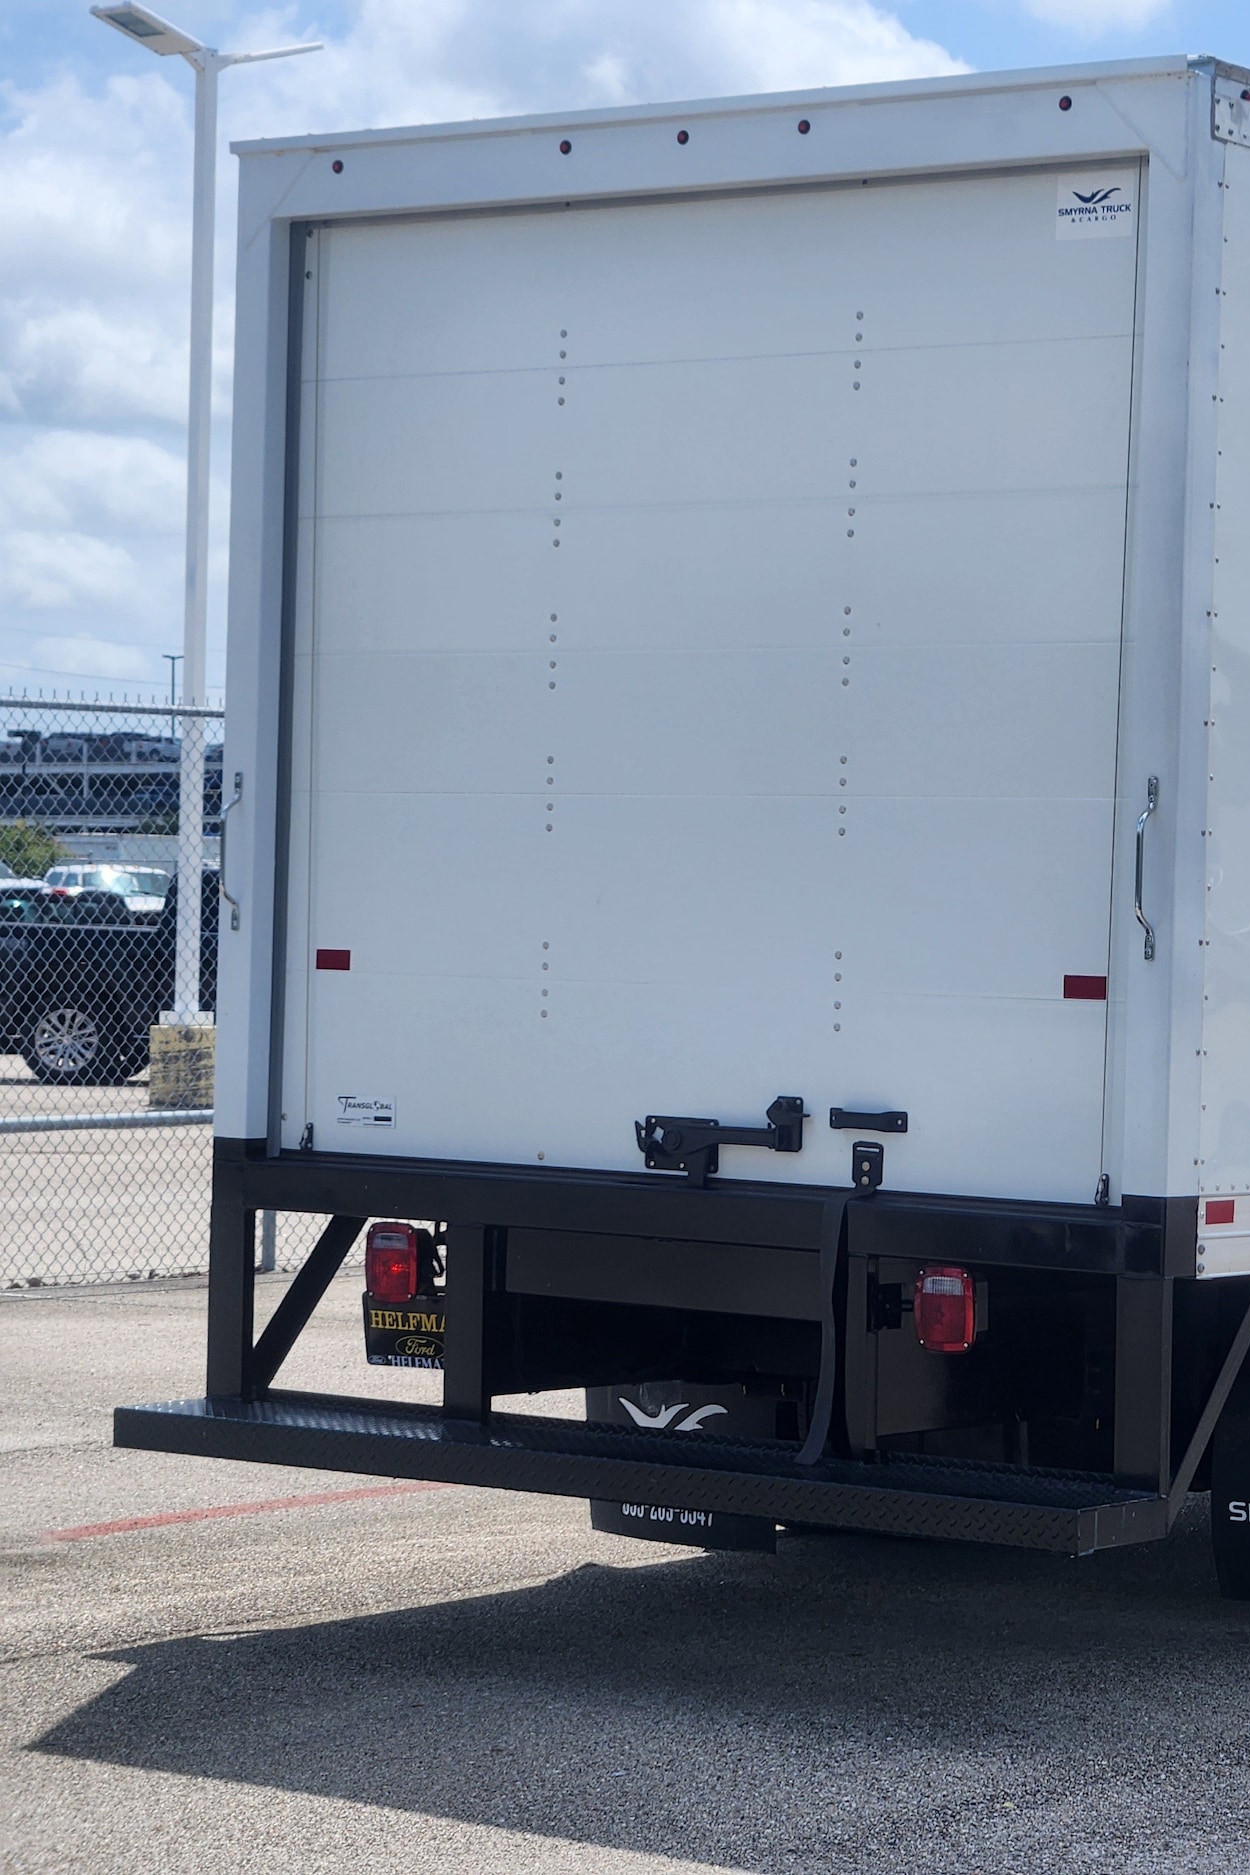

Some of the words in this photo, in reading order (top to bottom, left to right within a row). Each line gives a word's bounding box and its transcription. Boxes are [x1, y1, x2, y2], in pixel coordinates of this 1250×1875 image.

[1058, 206, 1098, 216] SMYRNA
[1101, 204, 1131, 214] TRUCK
[1079, 215, 1116, 223] CARGO
[405, 1338, 436, 1356] Ford
